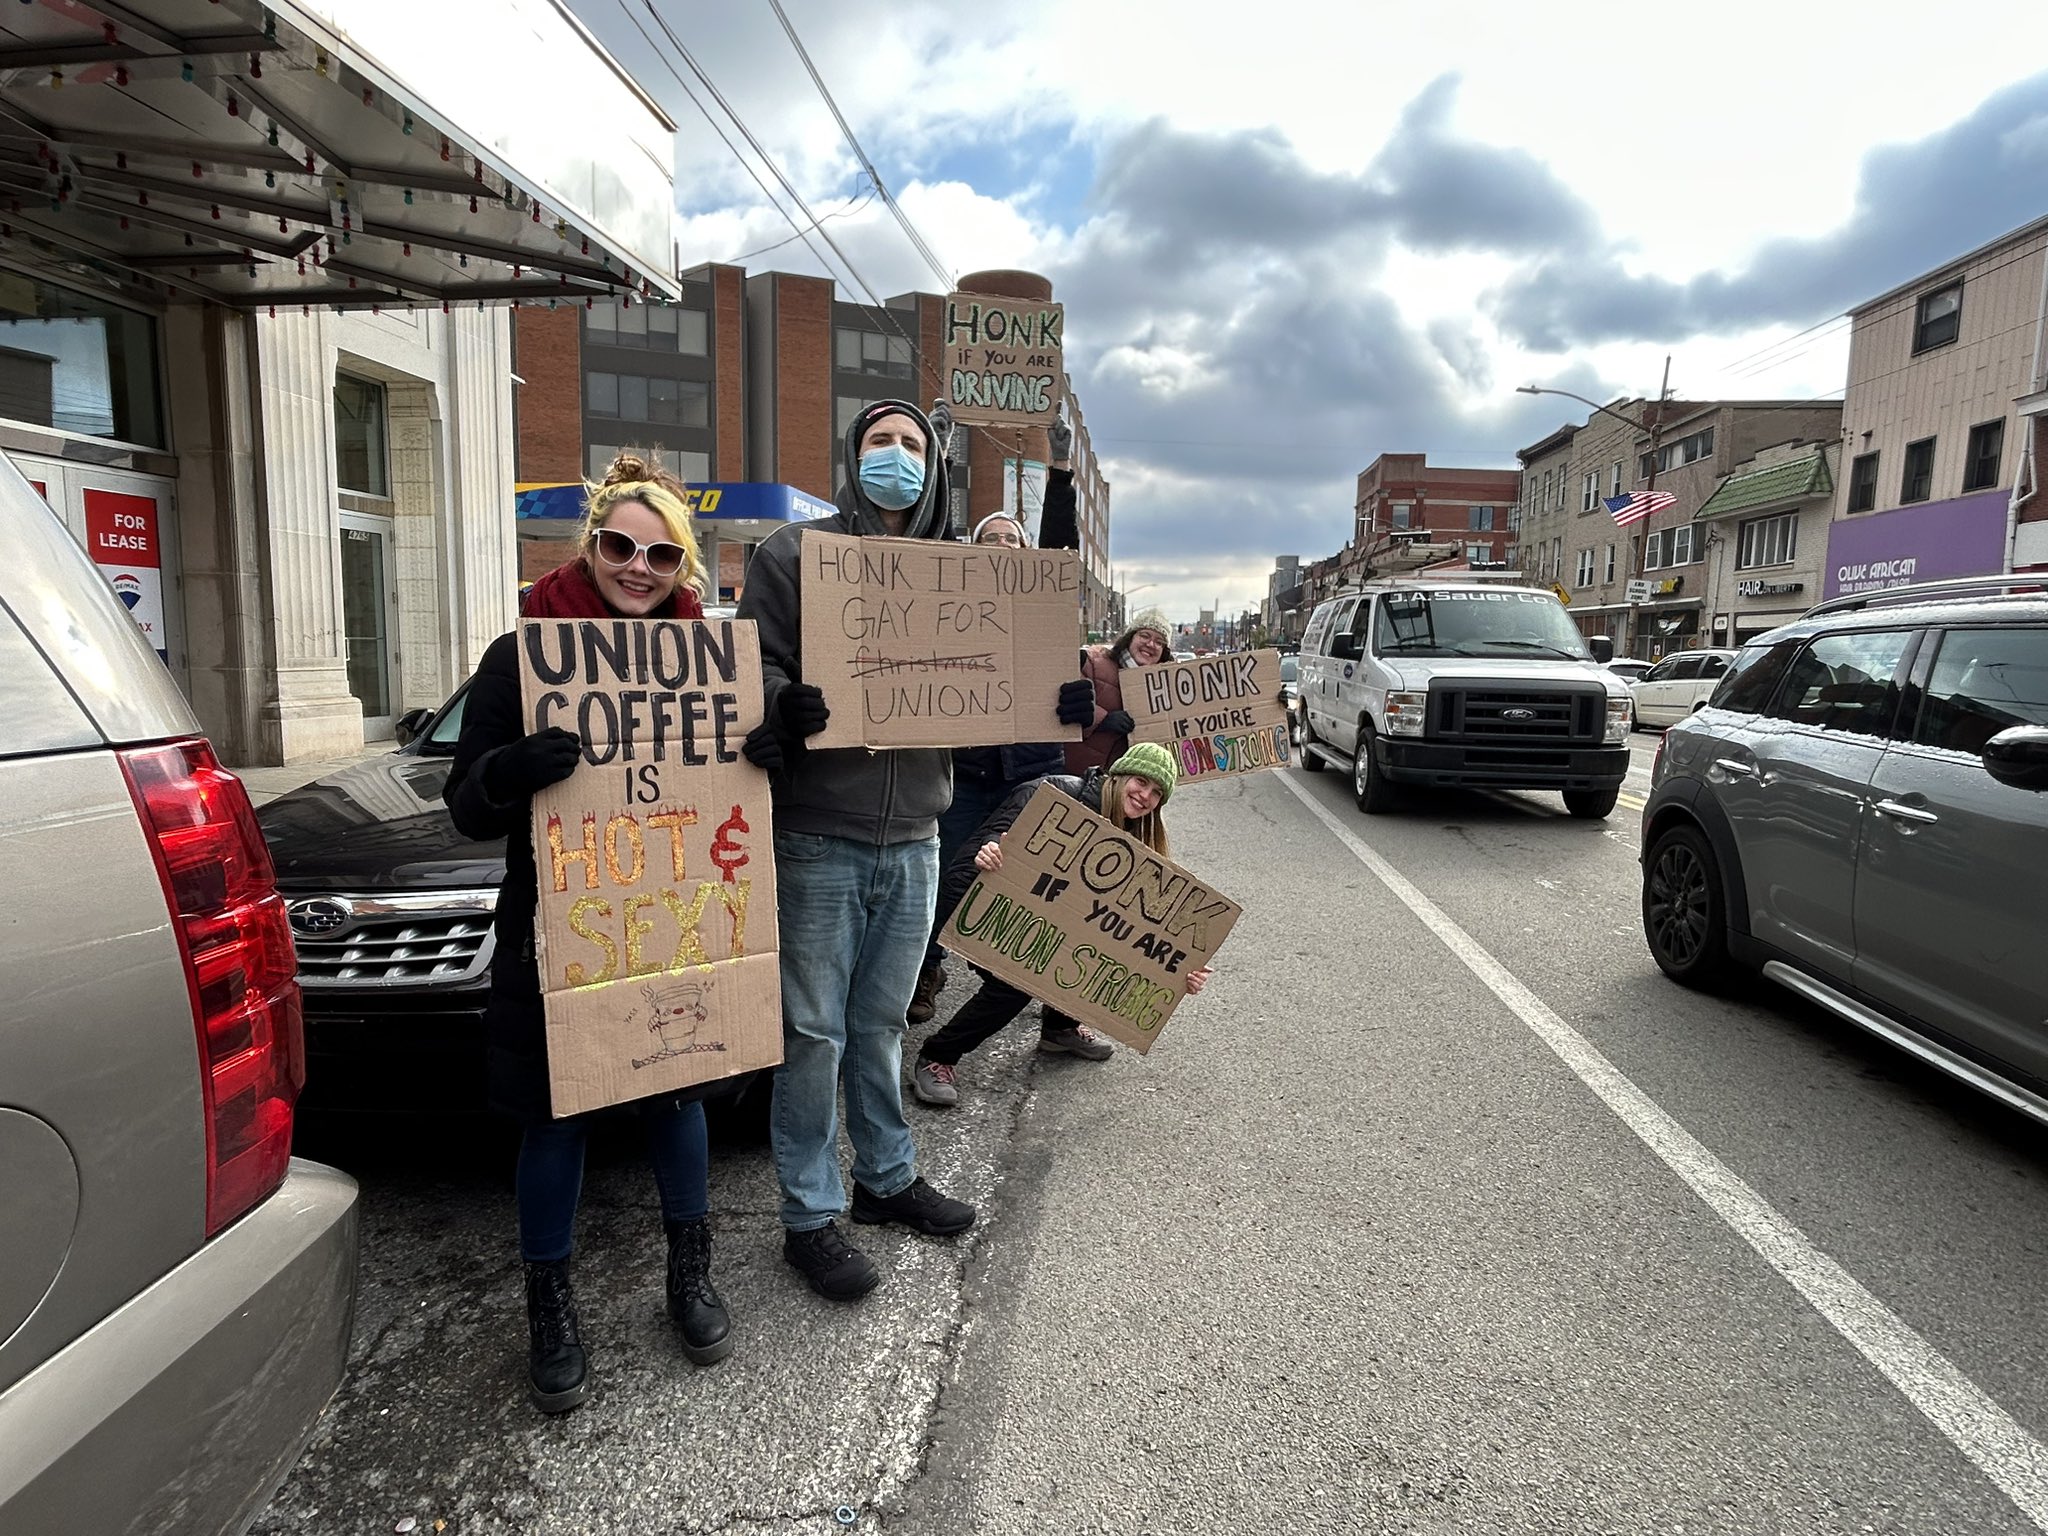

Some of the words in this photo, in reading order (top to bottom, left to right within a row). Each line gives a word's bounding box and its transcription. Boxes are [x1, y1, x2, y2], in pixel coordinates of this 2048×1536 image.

[945, 301, 1061, 349] HONK
[984, 349, 1017, 367] YOU
[1025, 354, 1055, 368] ARE
[99, 532, 148, 550] LEASE
[114, 513, 146, 531] FOR
[818, 543, 913, 591] HONK
[928, 556, 978, 593] IF
[988, 554, 1079, 596] YOURE
[1629, 587, 1647, 595] SCHOOL
[841, 597, 915, 640] GAY
[936, 601, 1008, 636] FOR
[524, 621, 737, 690] UNION
[865, 680, 1013, 724] UNIONS
[1145, 654, 1261, 715] HONK
[535, 690, 739, 767] COFFEE
[1173, 718, 1189, 739] IF
[625, 763, 661, 805] IS
[546, 803, 698, 893] HOT
[1024, 800, 1230, 952] HONK
[564, 876, 752, 993] SEXY
[1030, 872, 1070, 902] IF
[1083, 899, 1135, 941] YOU
[1131, 933, 1187, 974] ARE
[955, 881, 1066, 975] UNION
[1055, 943, 1175, 1031] STRONG
